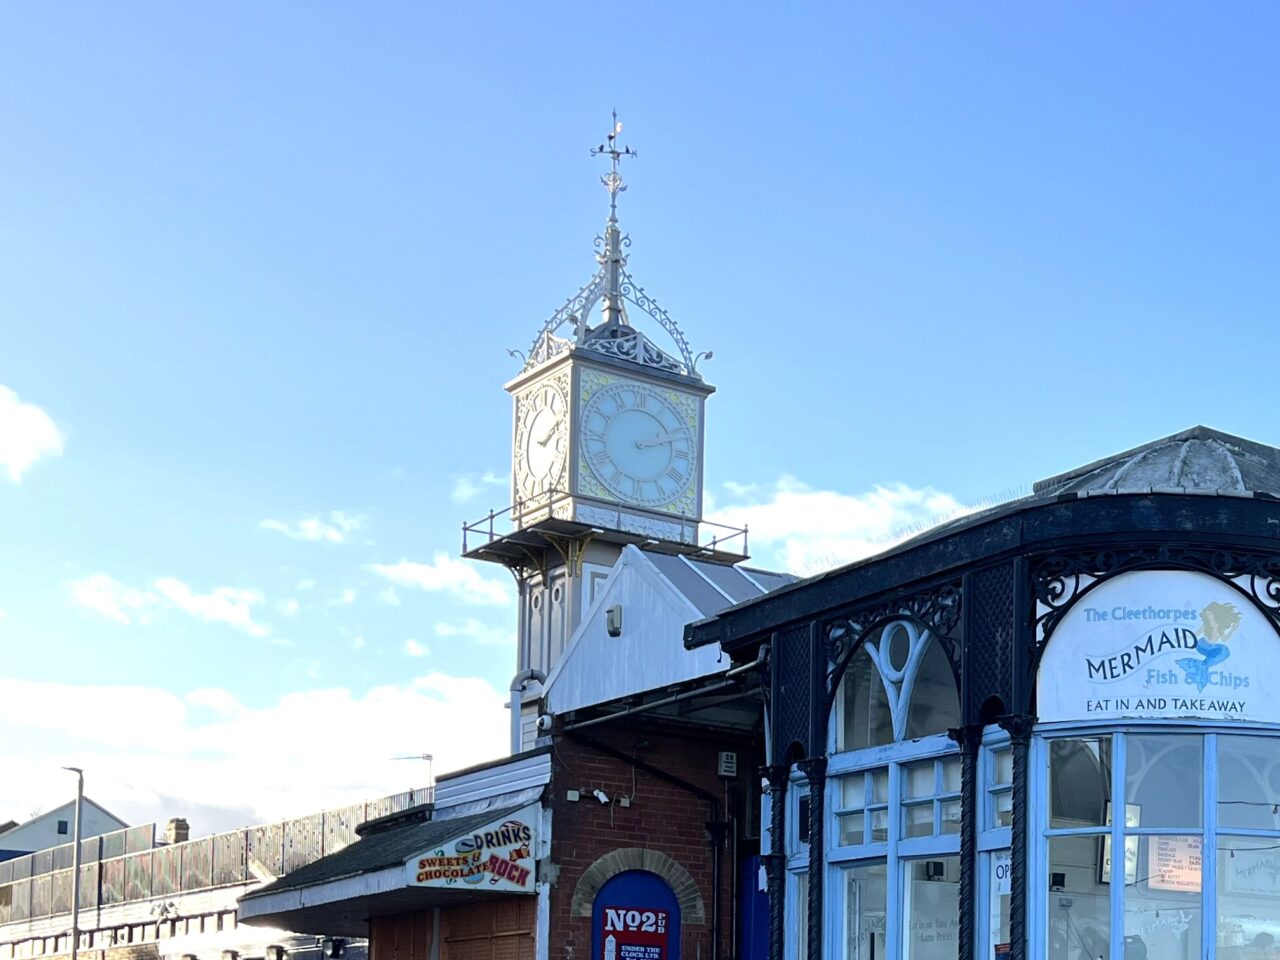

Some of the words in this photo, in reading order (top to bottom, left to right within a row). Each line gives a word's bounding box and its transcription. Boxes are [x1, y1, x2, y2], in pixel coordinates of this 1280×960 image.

[1084, 608, 1108, 622] The
[1111, 606, 1197, 621] Cleethorpes
[1087, 627, 1199, 680] MERMAID
[1147, 669, 1178, 685] Fish
[1208, 671, 1250, 688] Chips
[1087, 699, 1110, 712] EAT
[1116, 699, 1130, 711] IN
[1135, 698, 1167, 710] AND
[1172, 698, 1246, 713] TAKEAWAY
[473, 825, 532, 850] DRINKS
[416, 861, 490, 882] CHOCOLATE
[418, 856, 469, 869] SWEETS
[488, 853, 531, 888] ROCK
